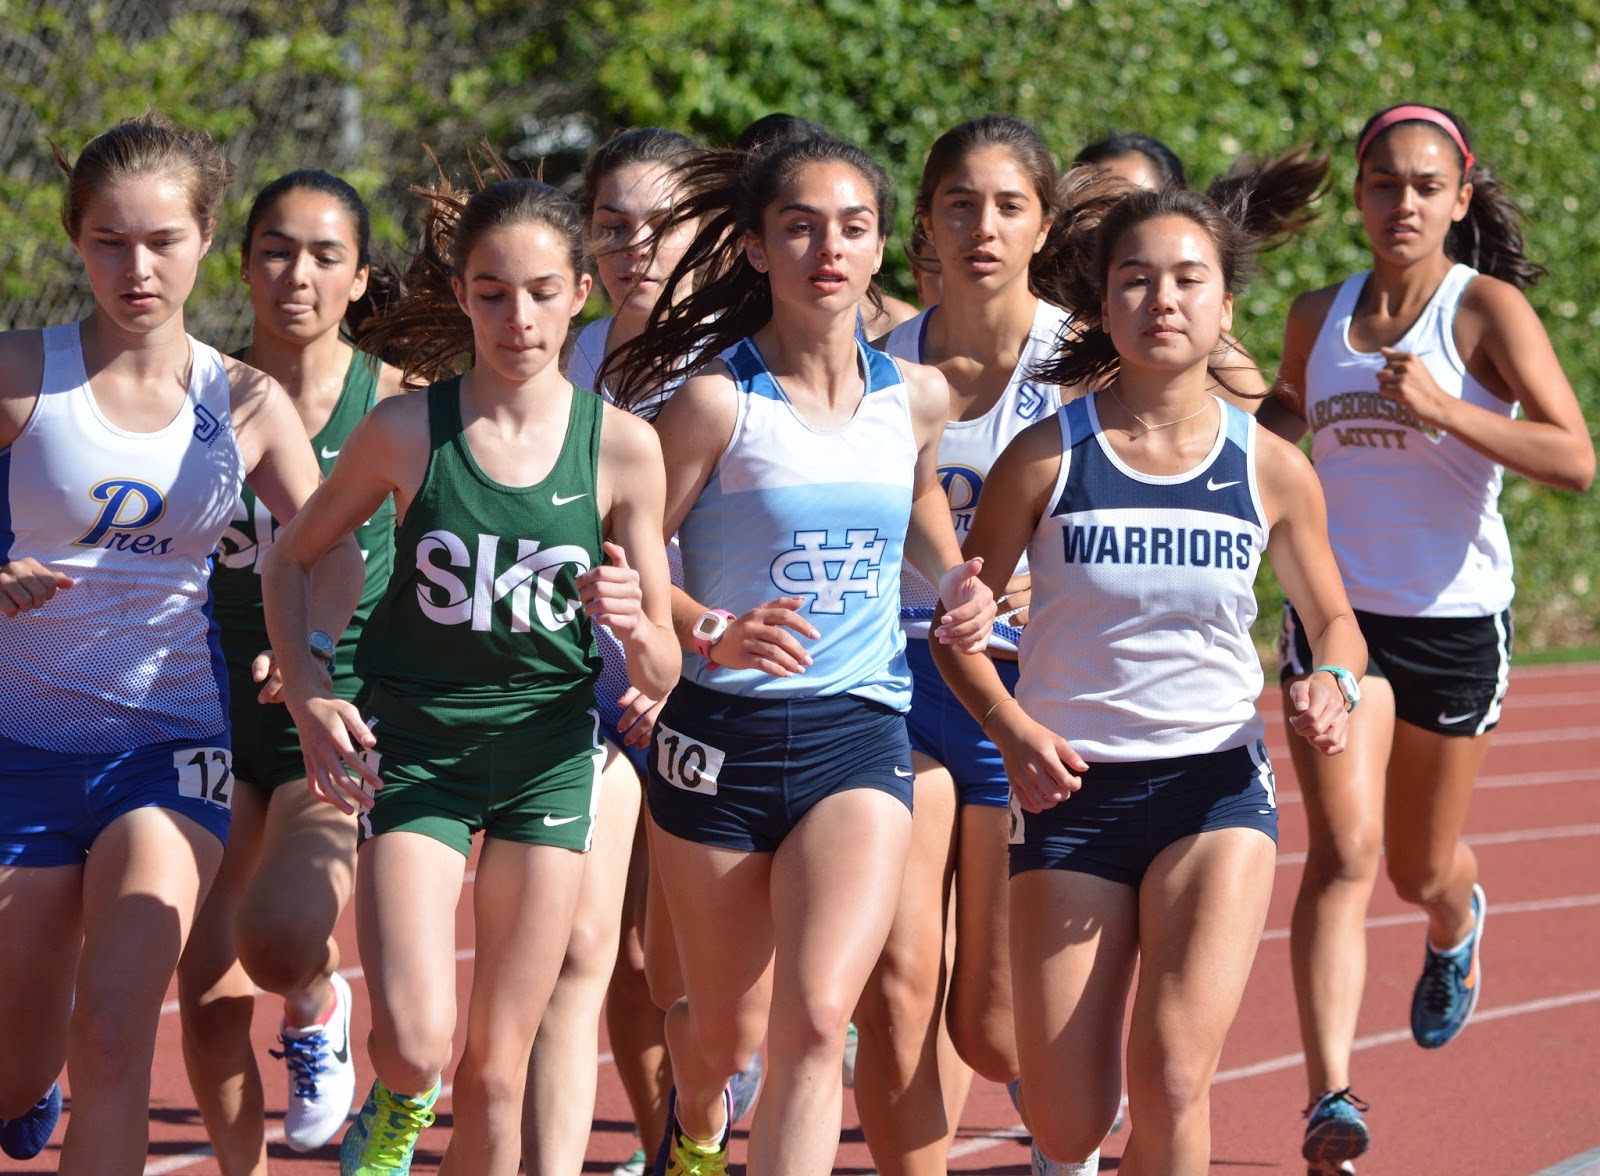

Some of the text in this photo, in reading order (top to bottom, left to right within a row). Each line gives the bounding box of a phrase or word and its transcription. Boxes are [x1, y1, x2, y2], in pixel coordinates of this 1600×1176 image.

[1333, 427, 1407, 450] WITTY
[70, 476, 175, 556] Pres
[936, 463, 986, 532] Pr
[1062, 525, 1253, 570] WARRIORS
[416, 530, 591, 633] SHC
[187, 750, 230, 804] 12
[664, 735, 707, 788] 10
